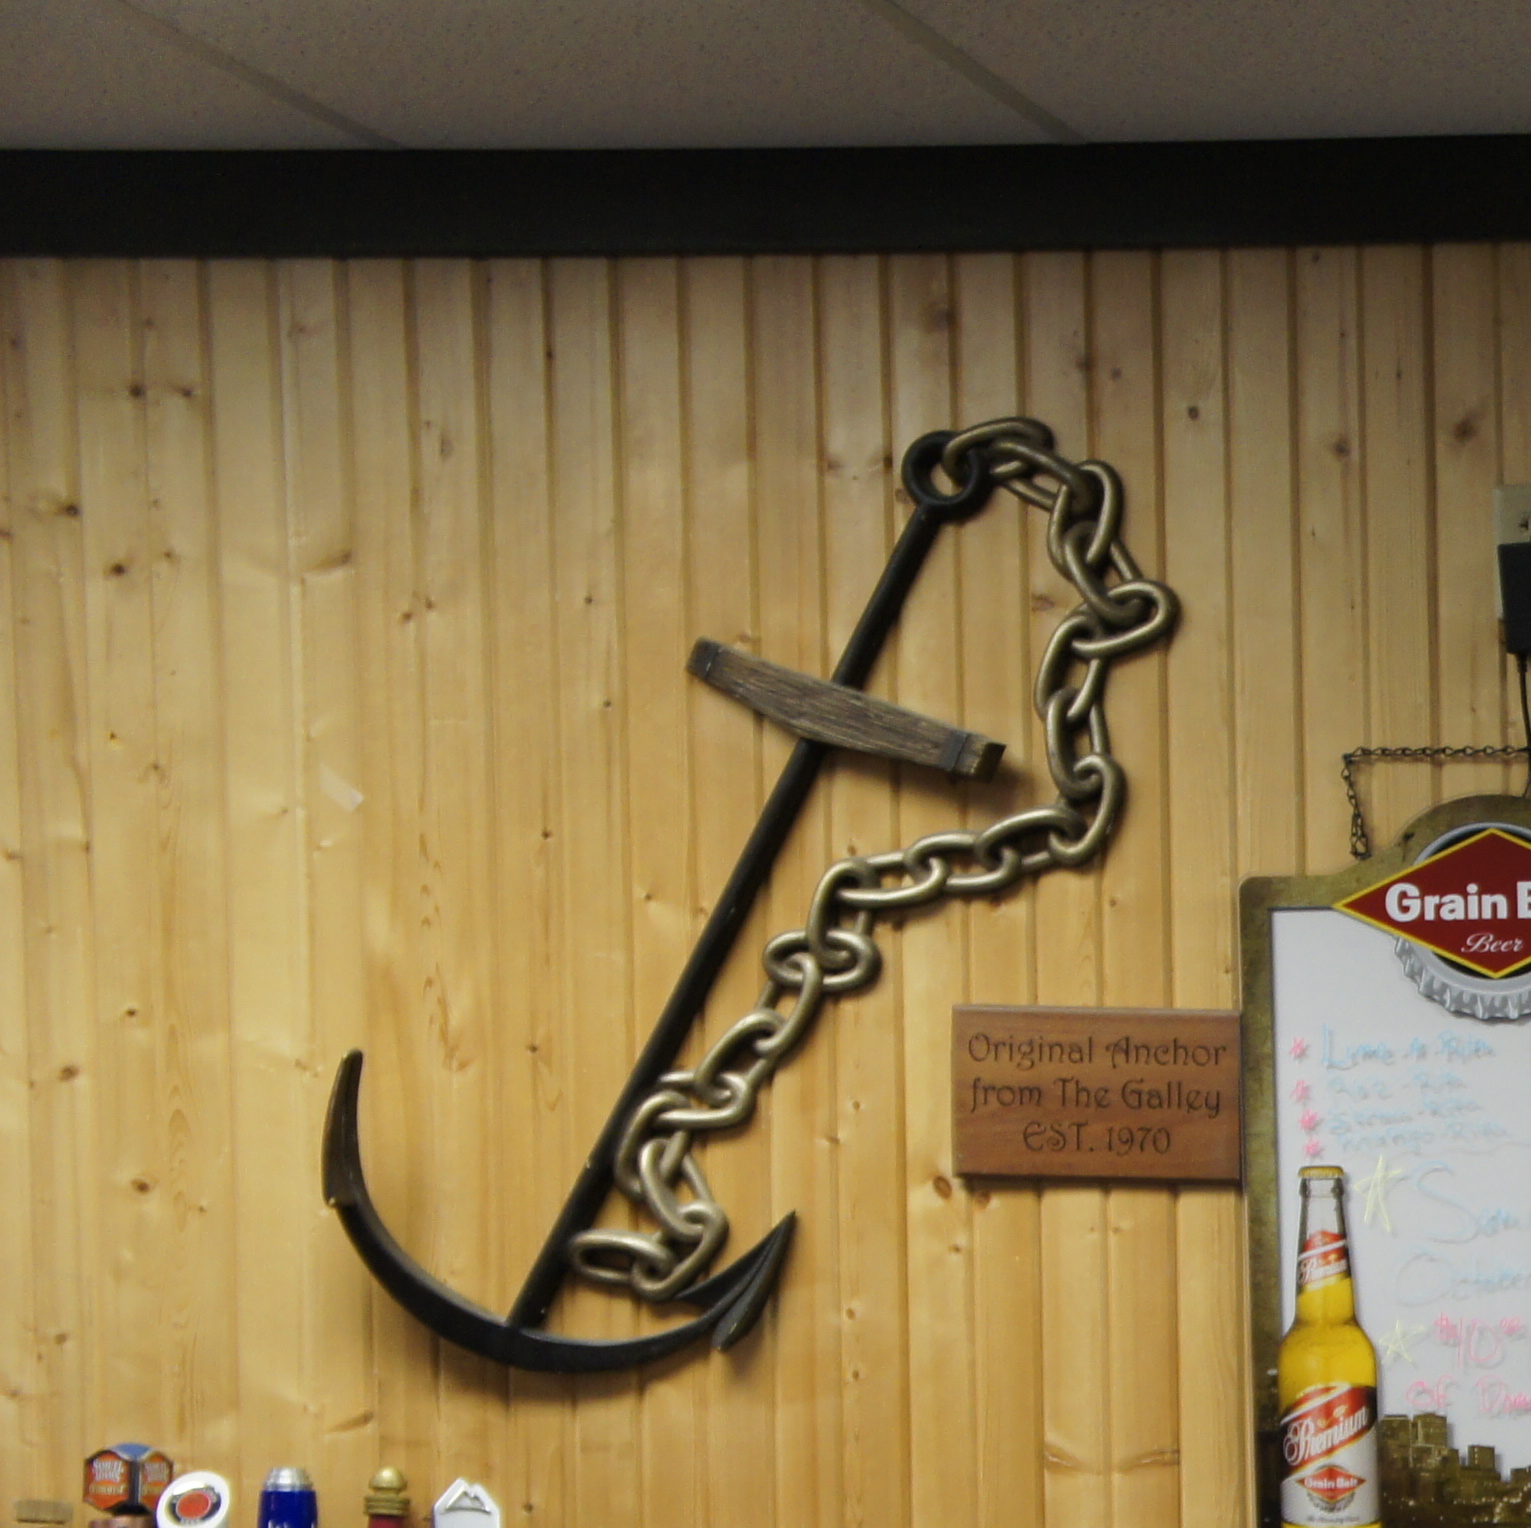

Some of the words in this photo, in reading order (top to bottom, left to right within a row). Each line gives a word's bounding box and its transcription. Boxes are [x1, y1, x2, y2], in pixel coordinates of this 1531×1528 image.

[1385, 883, 1507, 923] Grain
[1461, 932, 1525, 955] Beer
[968, 1033, 1093, 1071] Original
[1105, 1036, 1226, 1069] Anchor
[971, 1077, 1042, 1113] from
[1054, 1077, 1110, 1109] The
[1121, 1078, 1221, 1119] Galley
[1023, 1121, 1094, 1152] EST.
[1107, 1127, 1170, 1156] 1970
[1283, 1405, 1369, 1466] Premium
[1304, 1477, 1335, 1488] Grain
